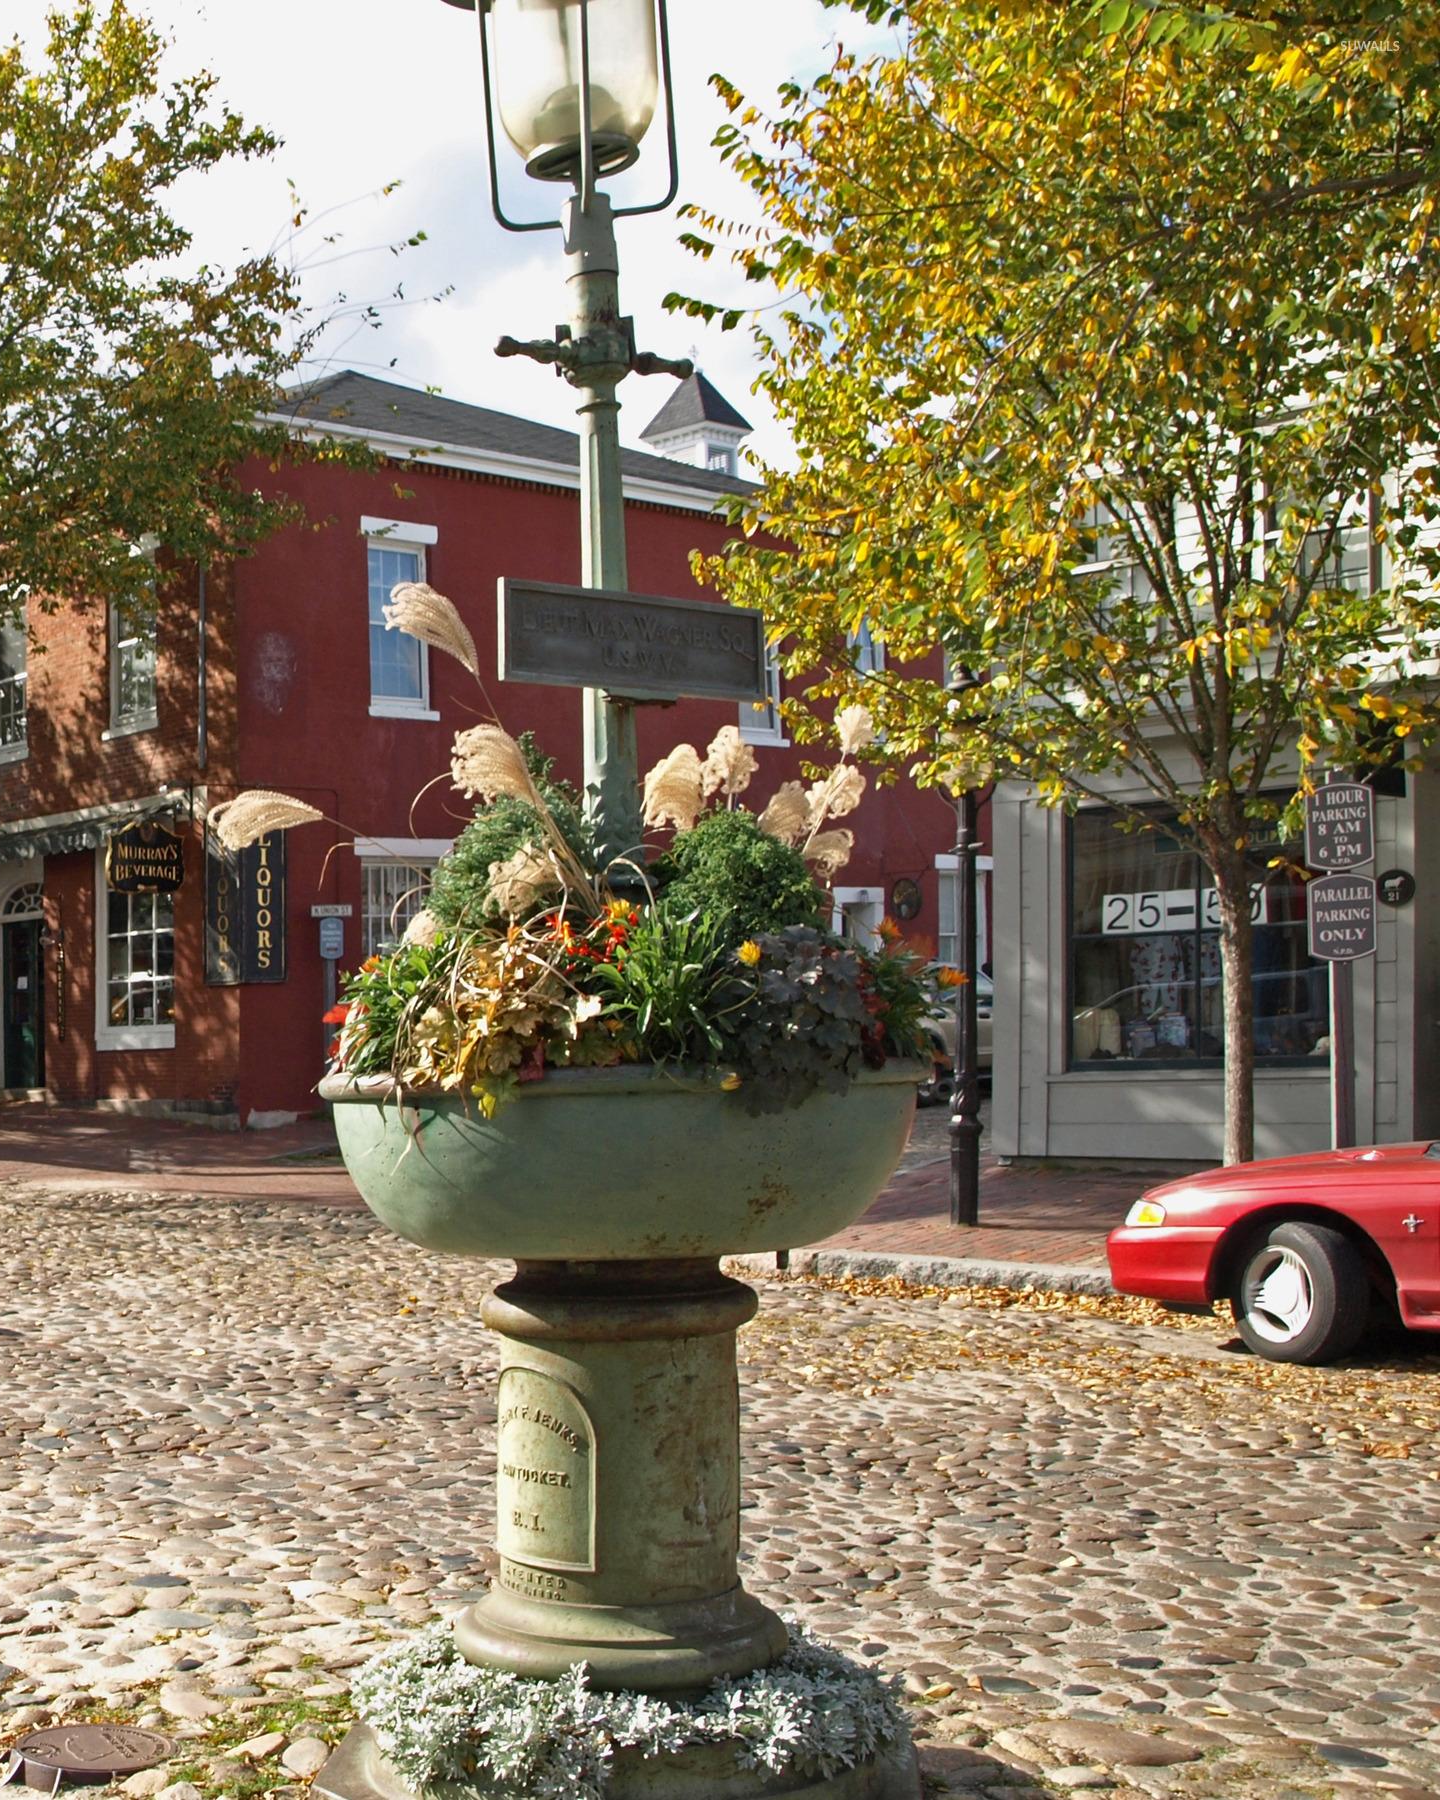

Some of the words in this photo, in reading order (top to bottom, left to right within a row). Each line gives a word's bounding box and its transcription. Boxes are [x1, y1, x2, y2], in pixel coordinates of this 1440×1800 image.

[1315, 793, 1320, 806] 1
[1326, 789, 1365, 806] HOUR
[1312, 806, 1367, 823] PARKING
[1318, 823, 1327, 836] 8
[1333, 820, 1361, 835] AM
[1333, 835, 1348, 844] TO
[117, 842, 178, 860] MURRAY'S
[1319, 846, 1328, 858] 6
[1336, 843, 1362, 857] PM
[115, 864, 180, 883] BEVERAGE
[256, 831, 272, 969] LIQUORS
[1314, 886, 1372, 903] PARALLEL
[216, 861, 229, 973] IQUORS
[1316, 907, 1371, 923] PARKING
[1320, 928, 1367, 942] ONLY
